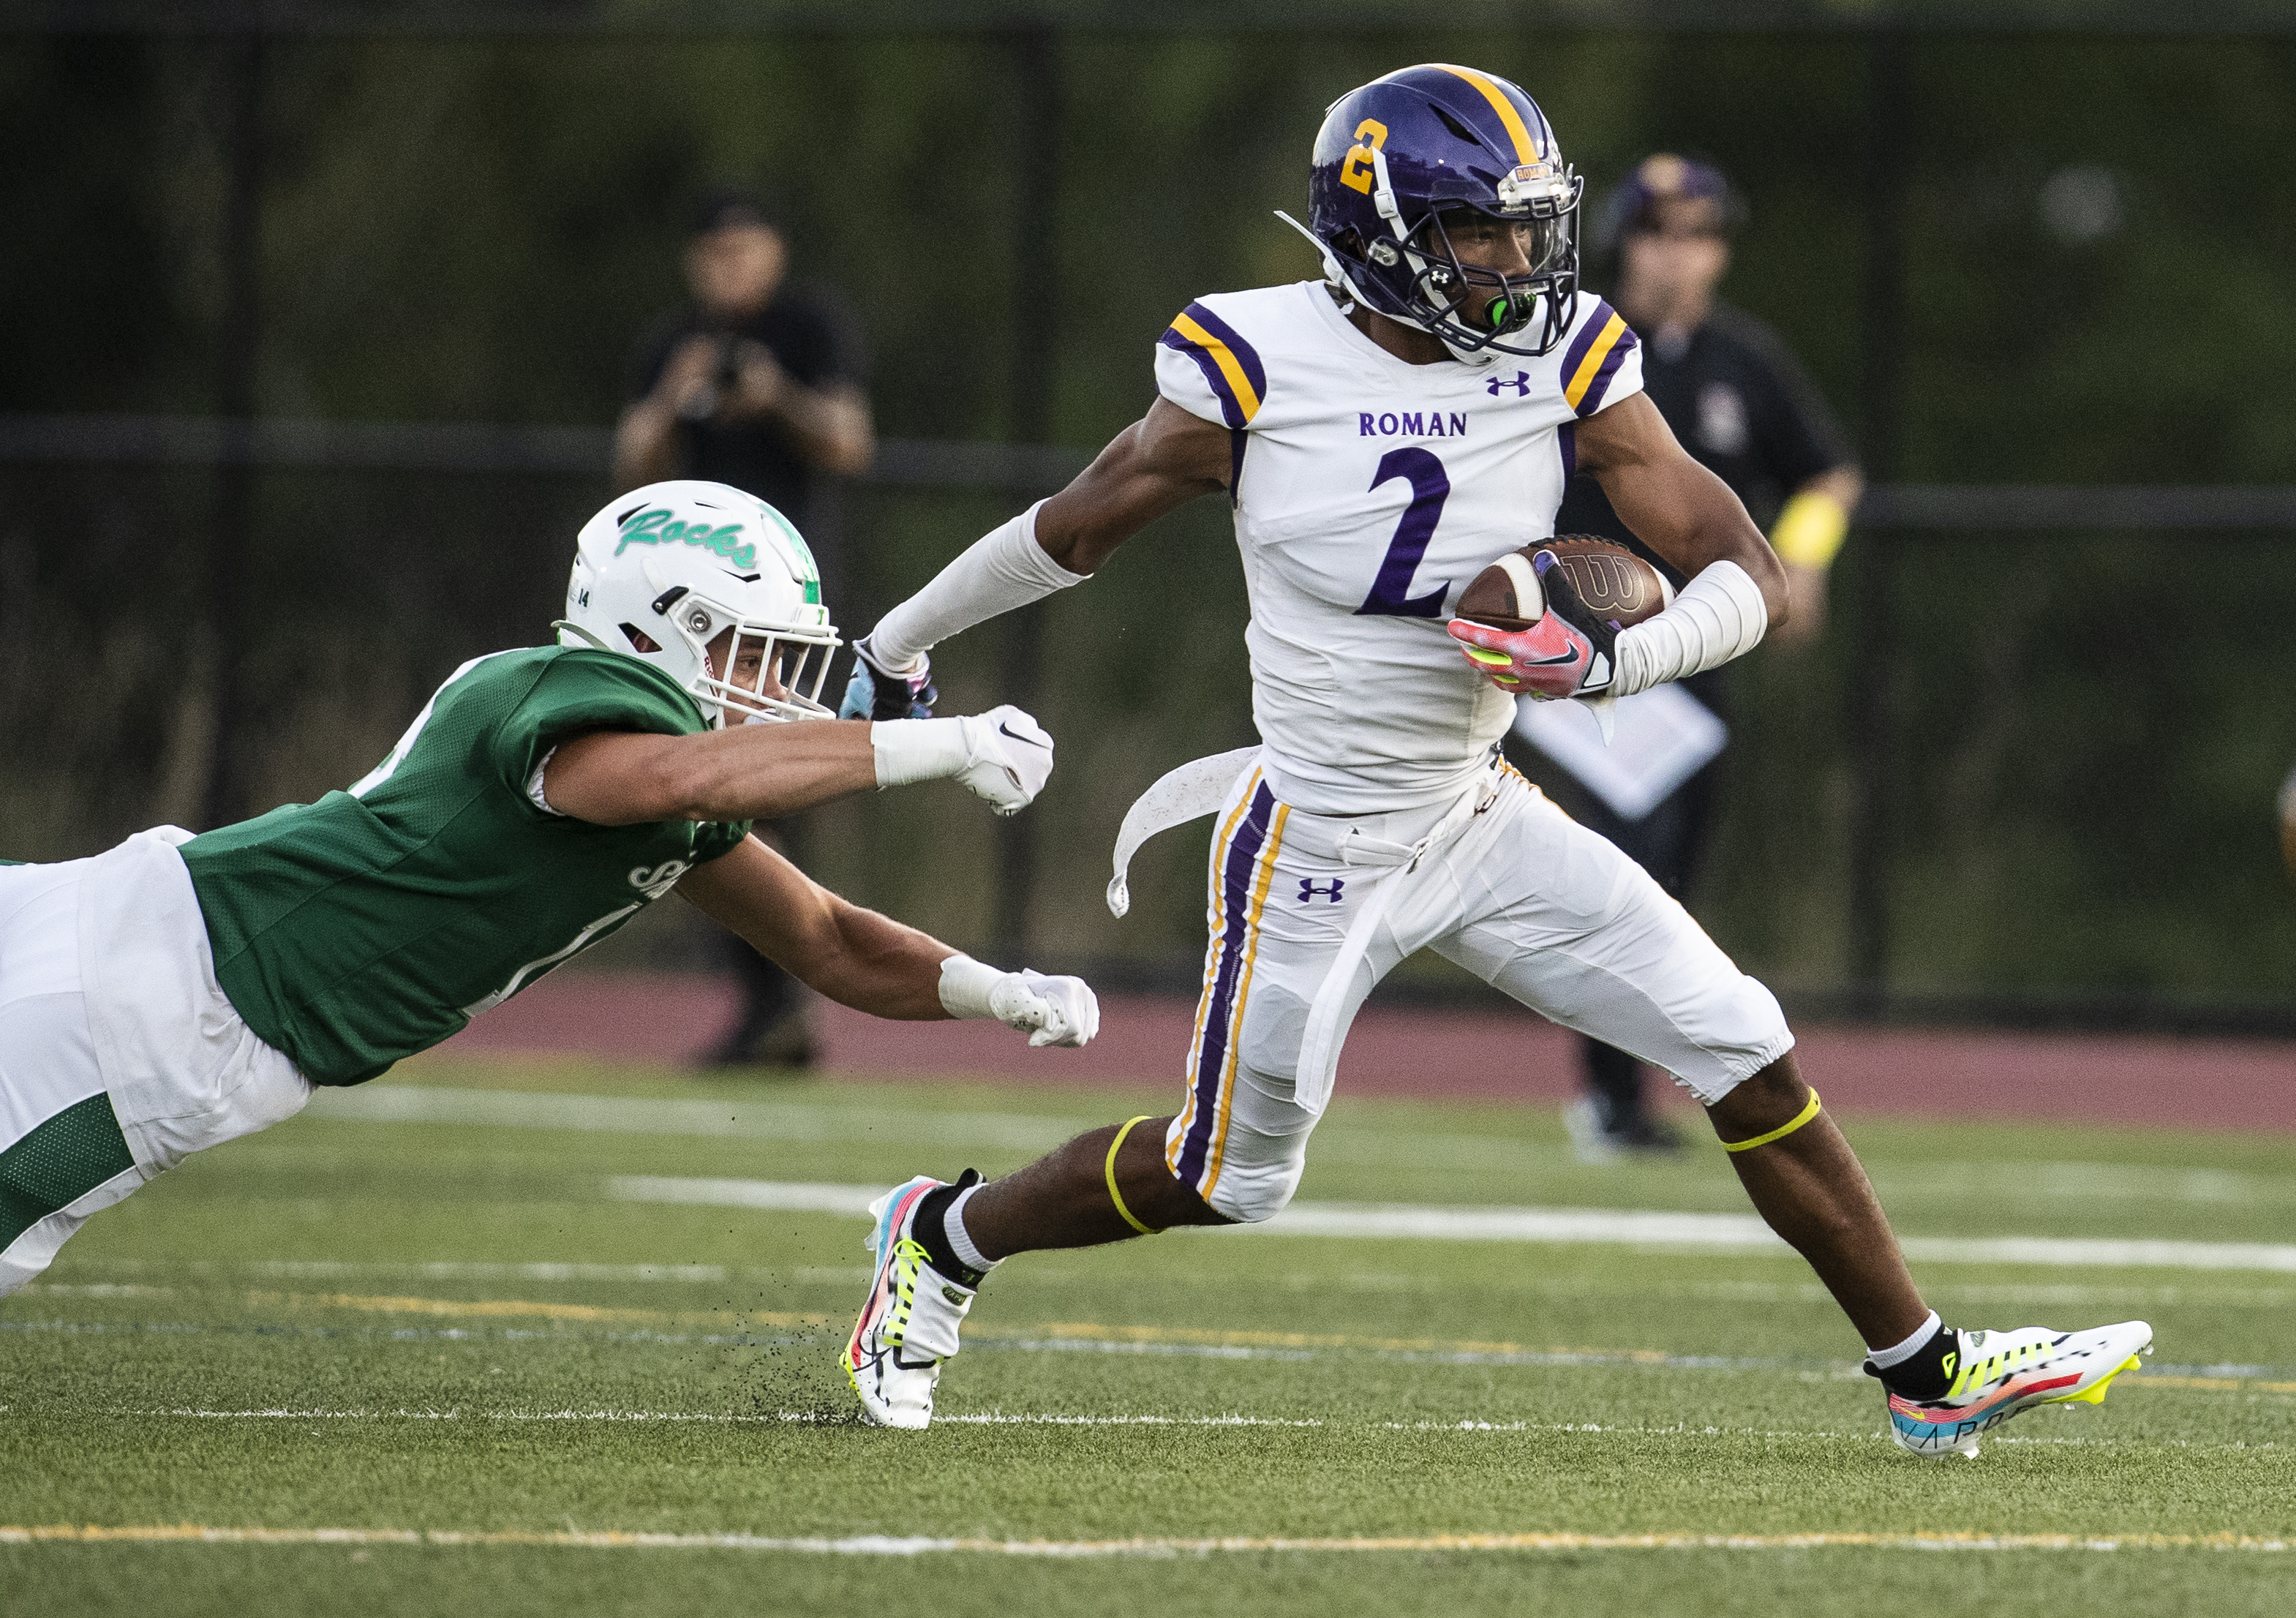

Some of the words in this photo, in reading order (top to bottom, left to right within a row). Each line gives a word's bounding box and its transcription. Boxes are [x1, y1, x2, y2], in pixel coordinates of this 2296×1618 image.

[1340, 118, 1388, 195] 2
[1359, 412, 1467, 437] ROMAN
[614, 508, 761, 570] Rocks
[1352, 447, 1450, 618] 2
[578, 587, 590, 608] 14
